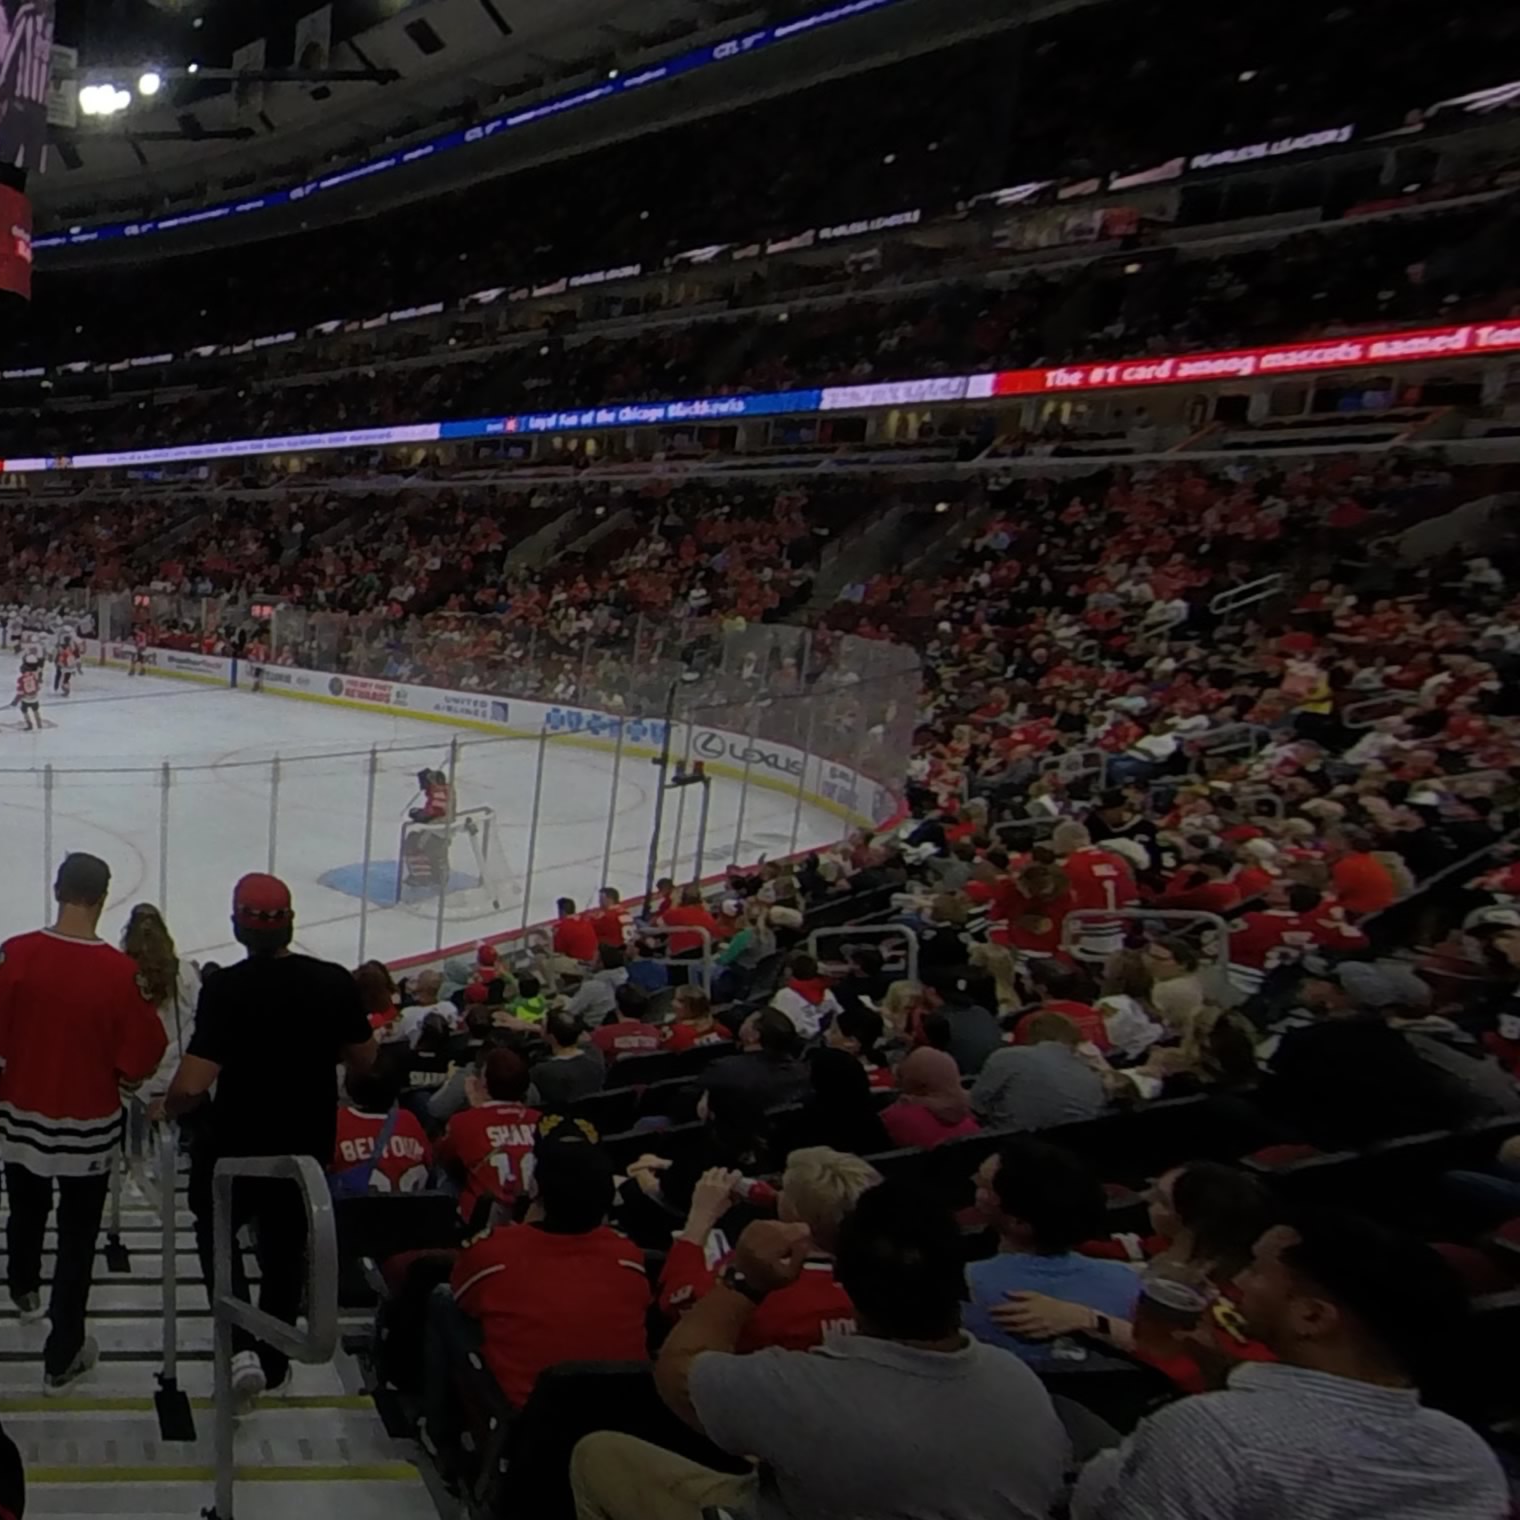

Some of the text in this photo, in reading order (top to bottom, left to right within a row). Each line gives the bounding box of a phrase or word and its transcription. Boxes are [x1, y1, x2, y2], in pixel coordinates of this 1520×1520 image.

[1046, 368, 1083, 388] The
[1122, 358, 1176, 382] card
[729, 743, 805, 777] LEXUS
